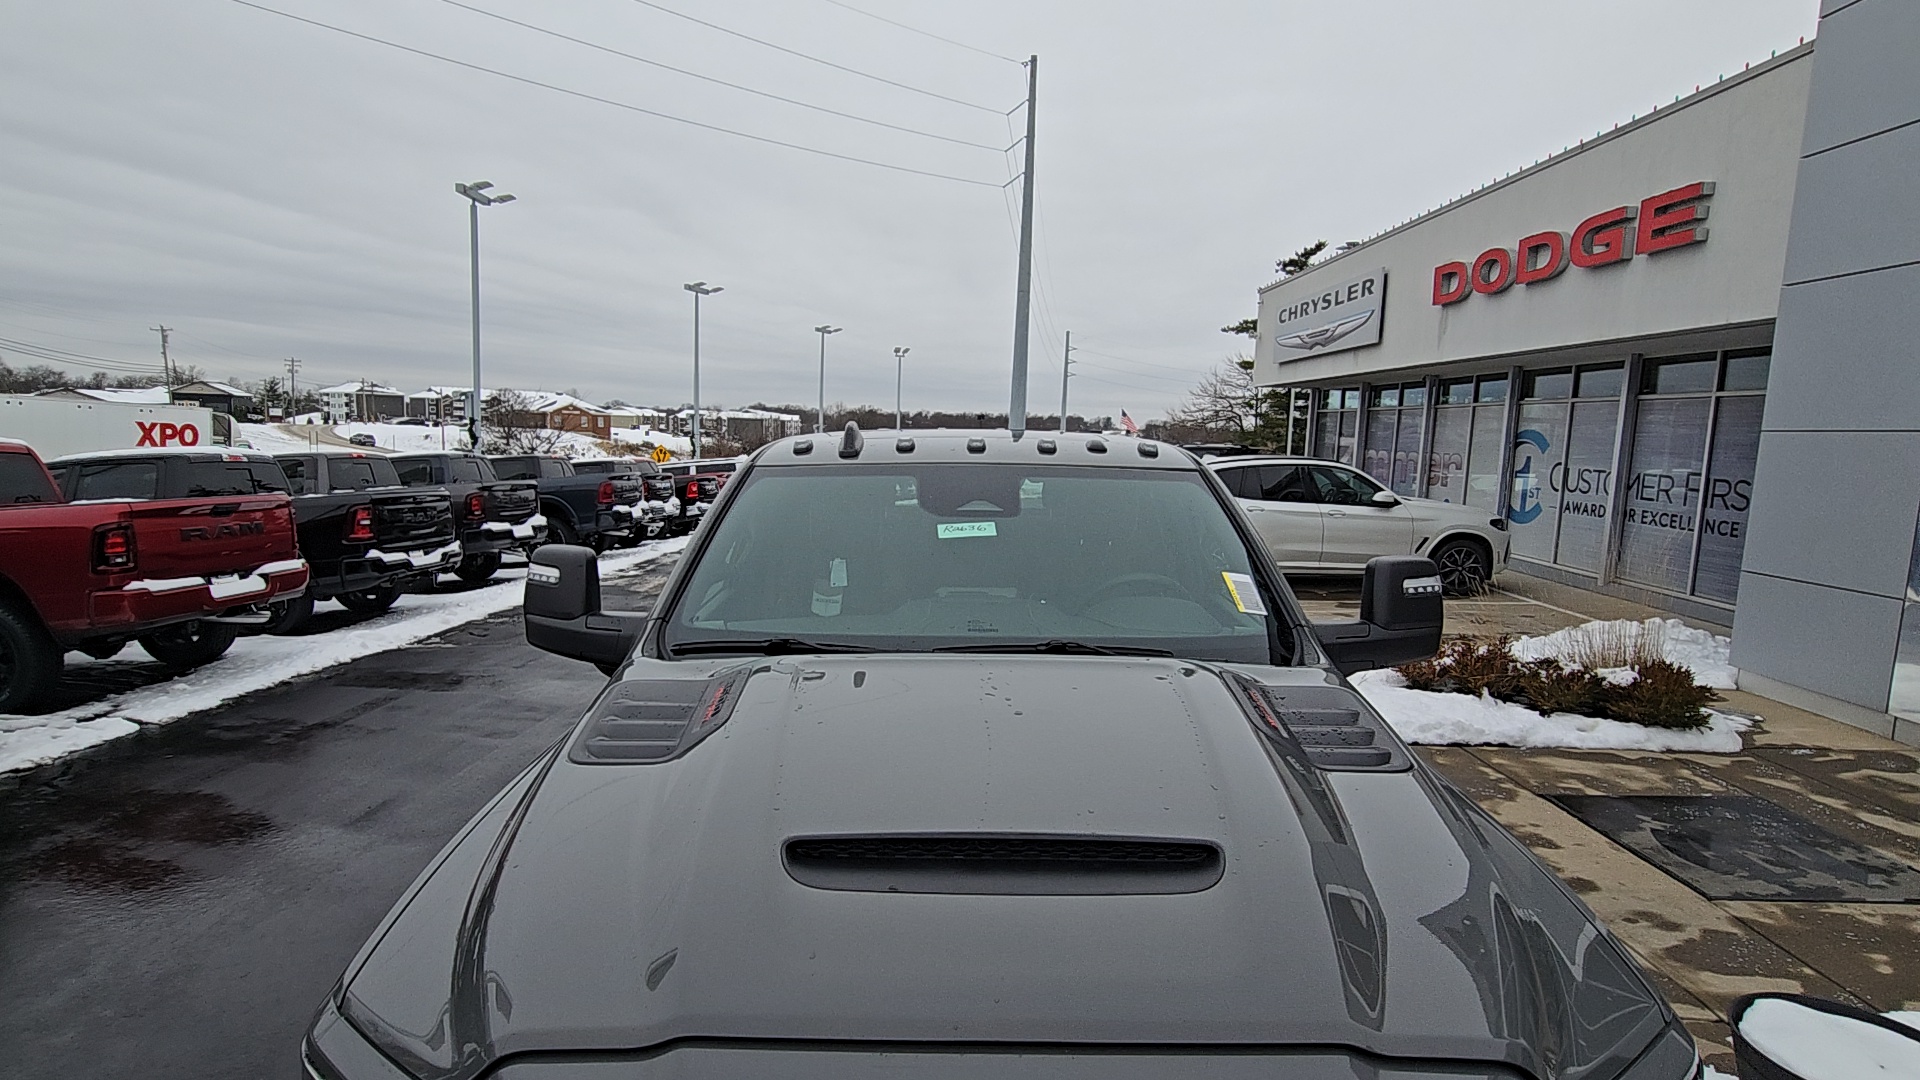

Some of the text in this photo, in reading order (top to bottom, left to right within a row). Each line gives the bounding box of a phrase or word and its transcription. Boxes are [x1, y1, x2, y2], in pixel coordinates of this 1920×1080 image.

[1432, 181, 1715, 306] DODGE
[1278, 278, 1375, 324] CHRYSLER
[135, 421, 199, 447] XPO
[180, 521, 265, 542] RAM
[1563, 501, 1606, 518] AWARD
[1641, 510, 1740, 538] EXCELLNCE
